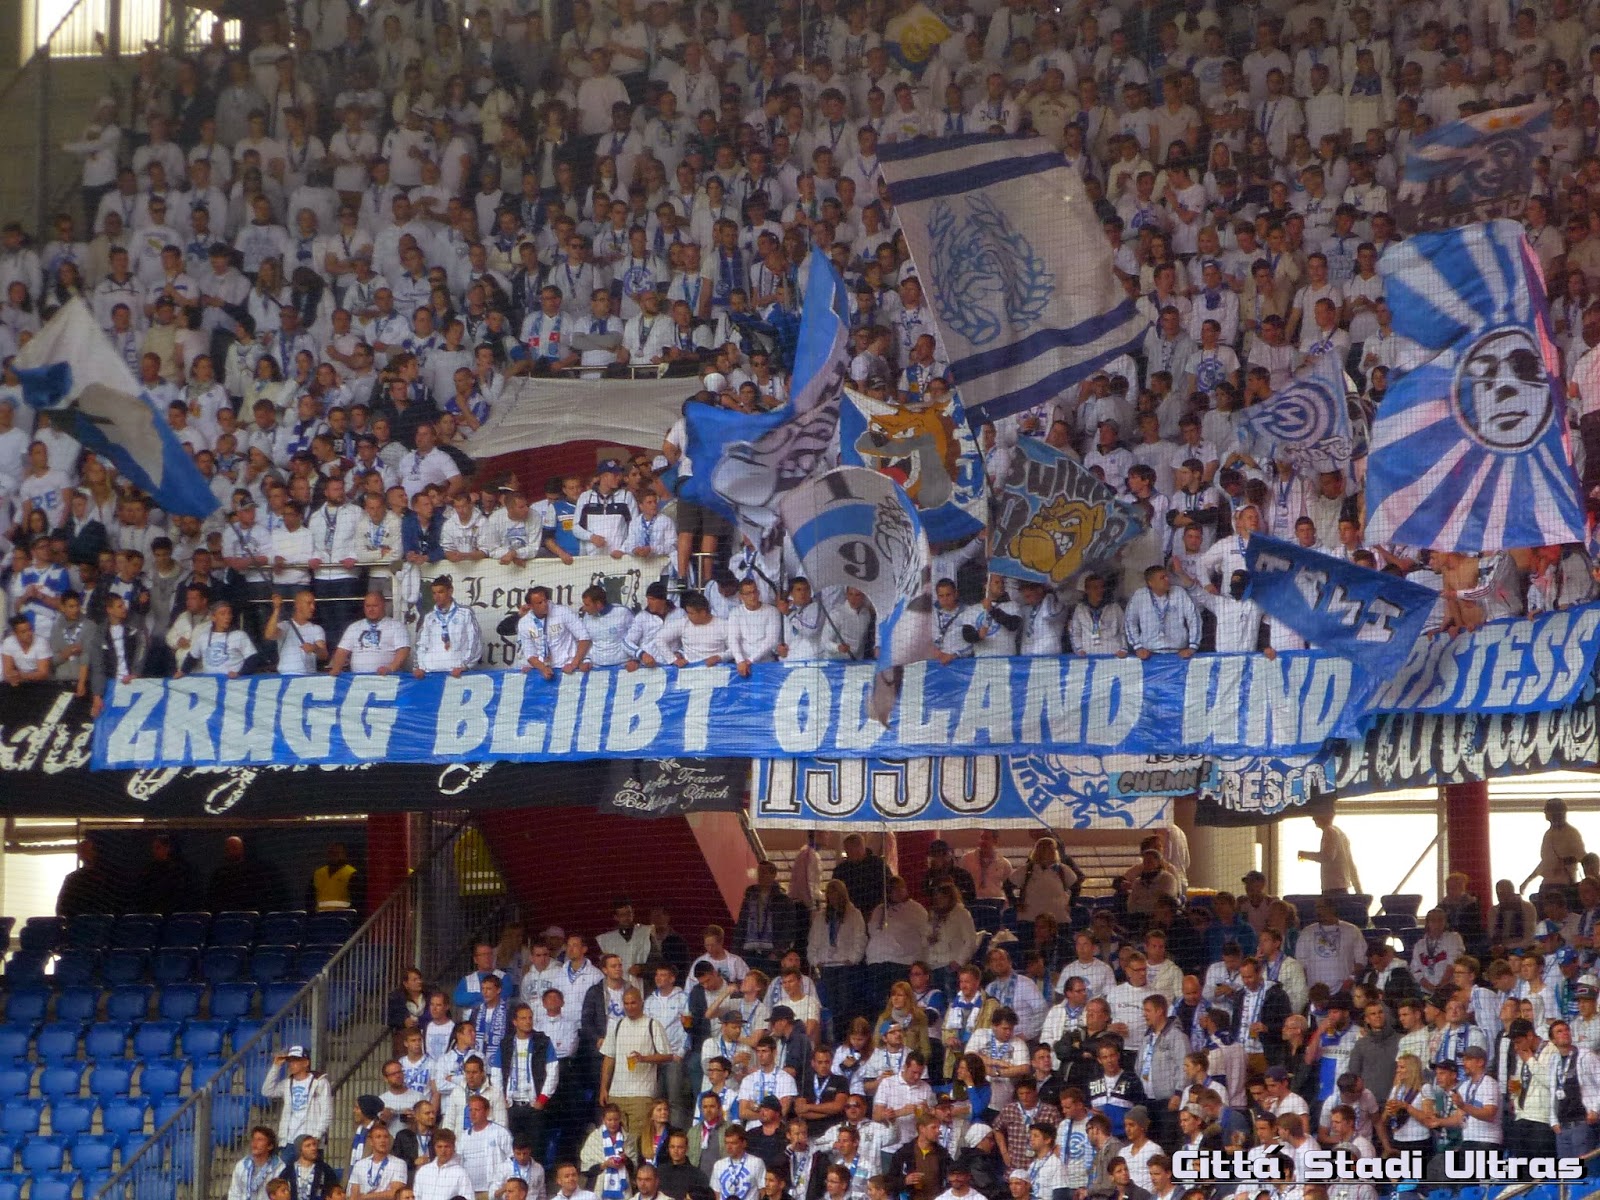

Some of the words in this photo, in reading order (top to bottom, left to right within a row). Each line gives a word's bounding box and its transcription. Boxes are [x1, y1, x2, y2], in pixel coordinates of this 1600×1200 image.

[462, 577, 575, 615] Legn
[106, 674, 402, 763] ZRUGG
[432, 662, 733, 756] BLIIBT
[1182, 655, 1353, 749] UND
